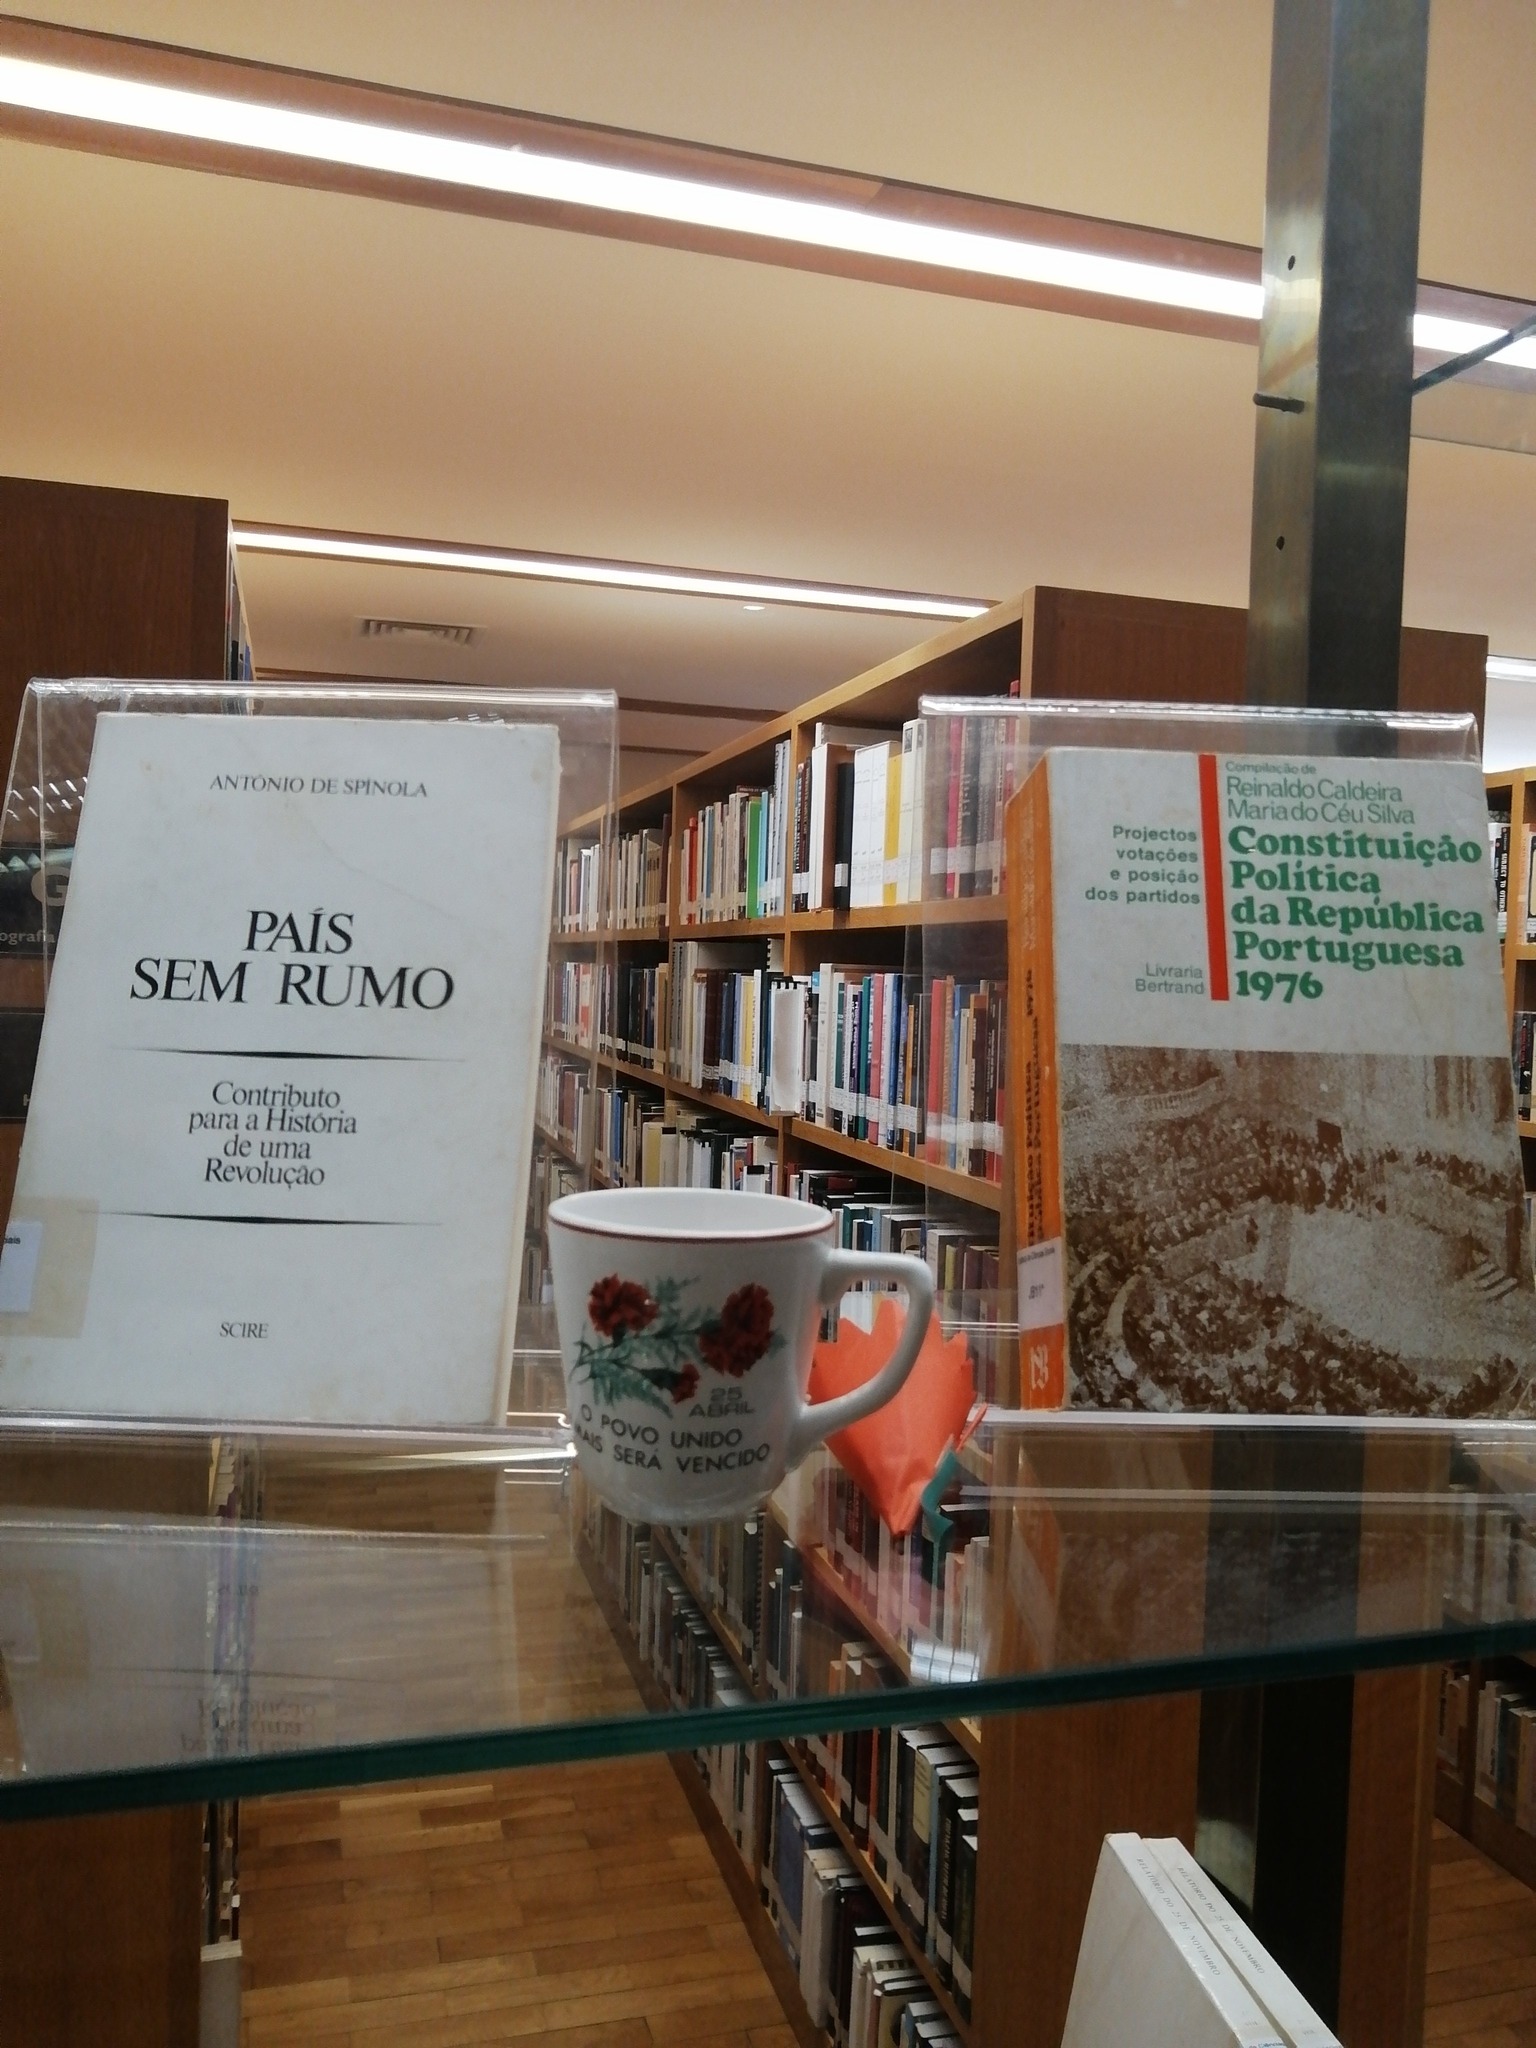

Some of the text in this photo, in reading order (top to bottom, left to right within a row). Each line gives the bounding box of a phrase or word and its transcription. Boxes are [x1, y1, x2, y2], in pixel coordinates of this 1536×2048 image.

[1225, 761, 1316, 776] Compilação de
[209, 774, 428, 798] ANTÓNIO DE SPÍNOLA
[1226, 776, 1403, 802] Reinaldo Caldeira
[1227, 799, 1415, 825] Maria do Céu Silva
[1112, 825, 1197, 843] Projectos
[1228, 825, 1482, 868] Constituição
[1116, 848, 1199, 864] votações
[1110, 869, 1199, 885] e posição
[1229, 860, 1381, 893] Política
[1085, 887, 1201, 905] dos partidos
[1231, 896, 1485, 936] da República
[242, 907, 354, 955] PAÍS
[1233, 931, 1465, 971] Portuguesa
[130, 957, 455, 1010] SEM RUMO
[1145, 963, 1204, 979] Livraria
[1135, 978, 1205, 995] Bertrand
[1236, 970, 1323, 1003] 1976
[212, 1080, 341, 1109] Contributo
[188, 1107, 357, 1134] para a História
[223, 1133, 311, 1160] de uma
[205, 1157, 325, 1191] Revolução
[220, 1320, 269, 1339] SCIRE
[711, 1386, 743, 1401] 25
[689, 1402, 755, 1418] ABRIL
[581, 1403, 743, 1449] O POVO UNIDO
[613, 1444, 662, 1470] SERÁ
[676, 1443, 770, 1474] VENCIDO
[1163, 1897, 1174, 1908] DO
[1179, 1921, 1190, 1932] DE
[1189, 1935, 1221, 1976] NOVEMBRO
[1205, 1903, 1216, 1913] DO
[1222, 1924, 1233, 1933] DE
[1232, 1936, 1265, 1974] NOVEMBRO
